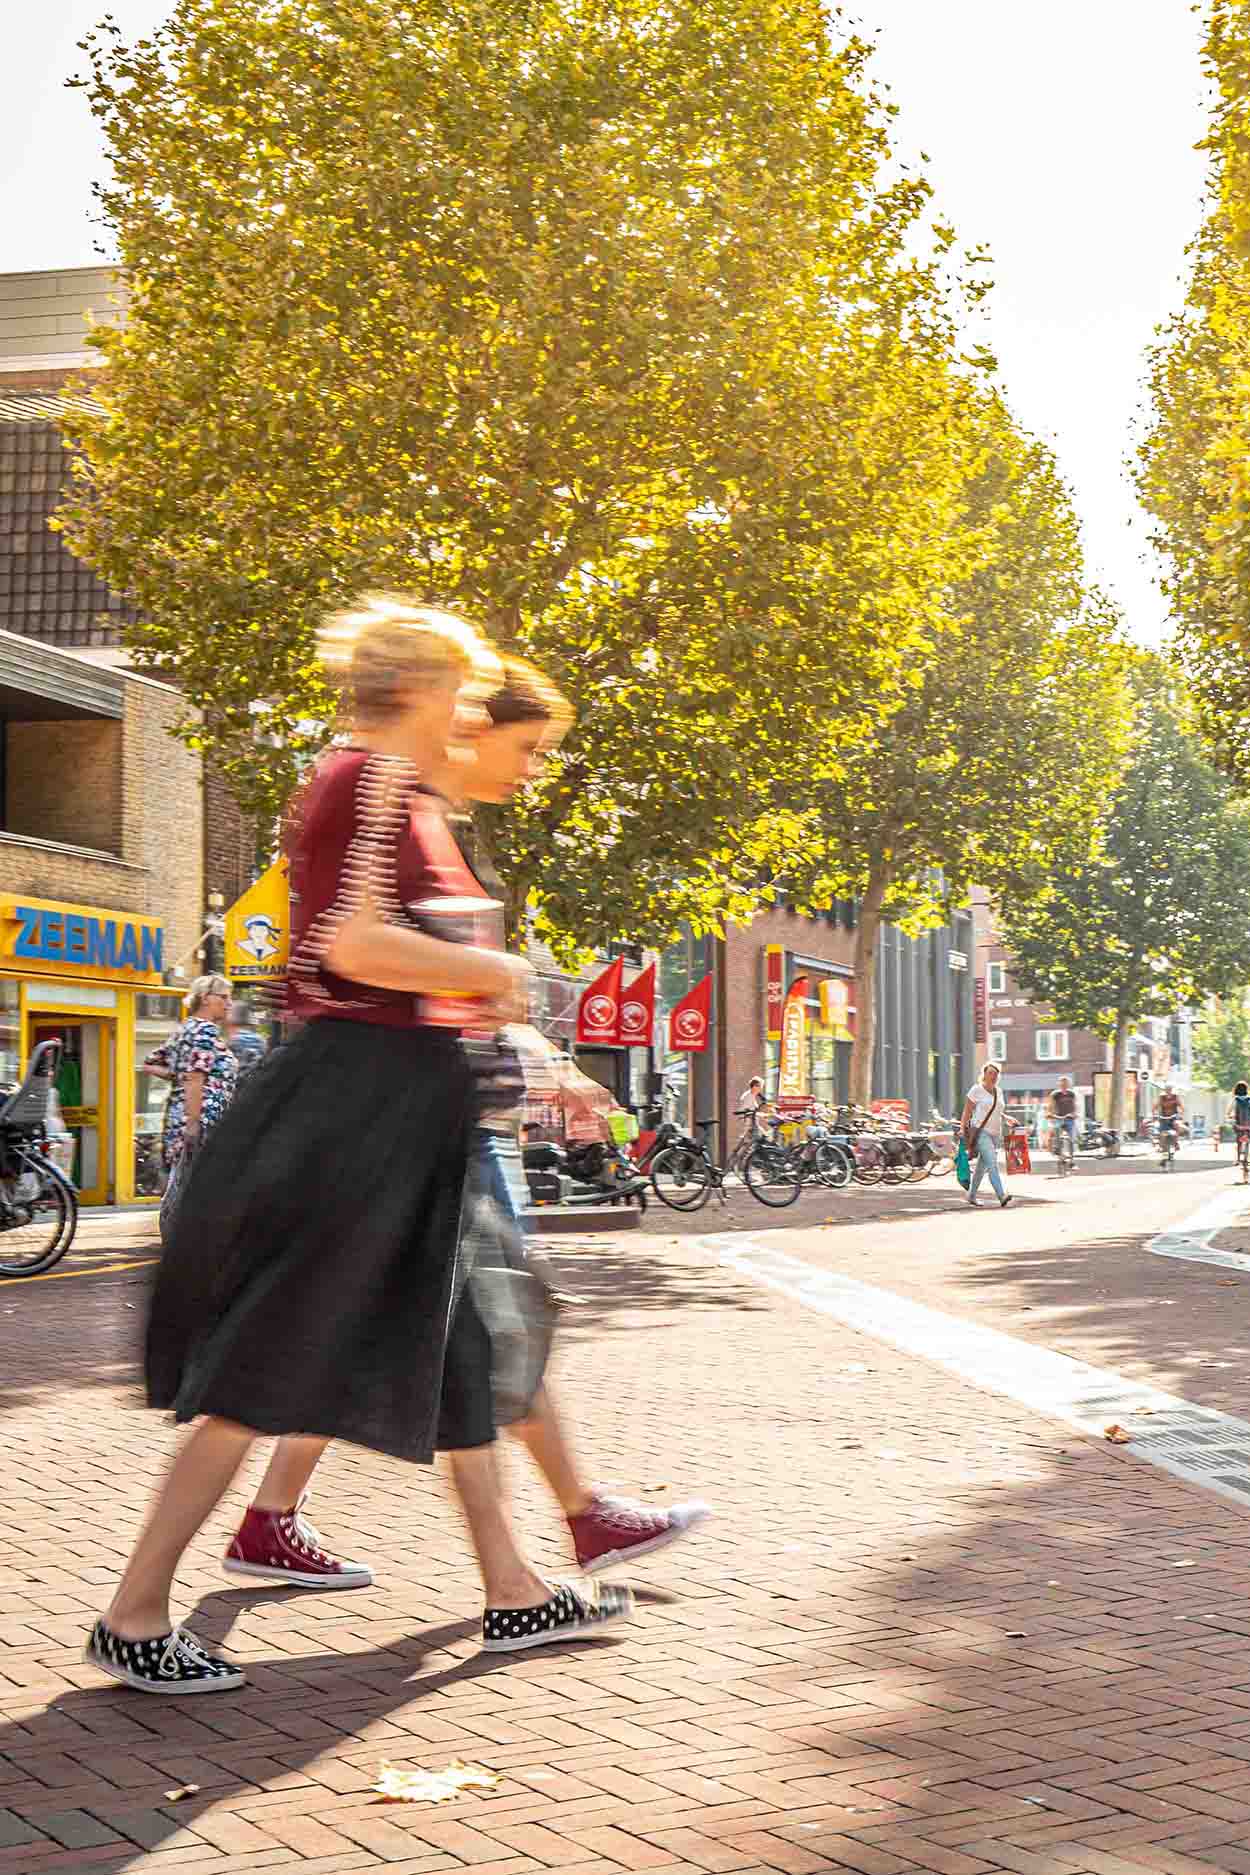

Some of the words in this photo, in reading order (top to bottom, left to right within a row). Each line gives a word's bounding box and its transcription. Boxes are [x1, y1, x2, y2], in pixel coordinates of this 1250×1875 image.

[15, 906, 164, 972] ZEEMAN
[230, 965, 287, 976] ZEEMAN
[783, 1012, 801, 1086] Kruidvat
